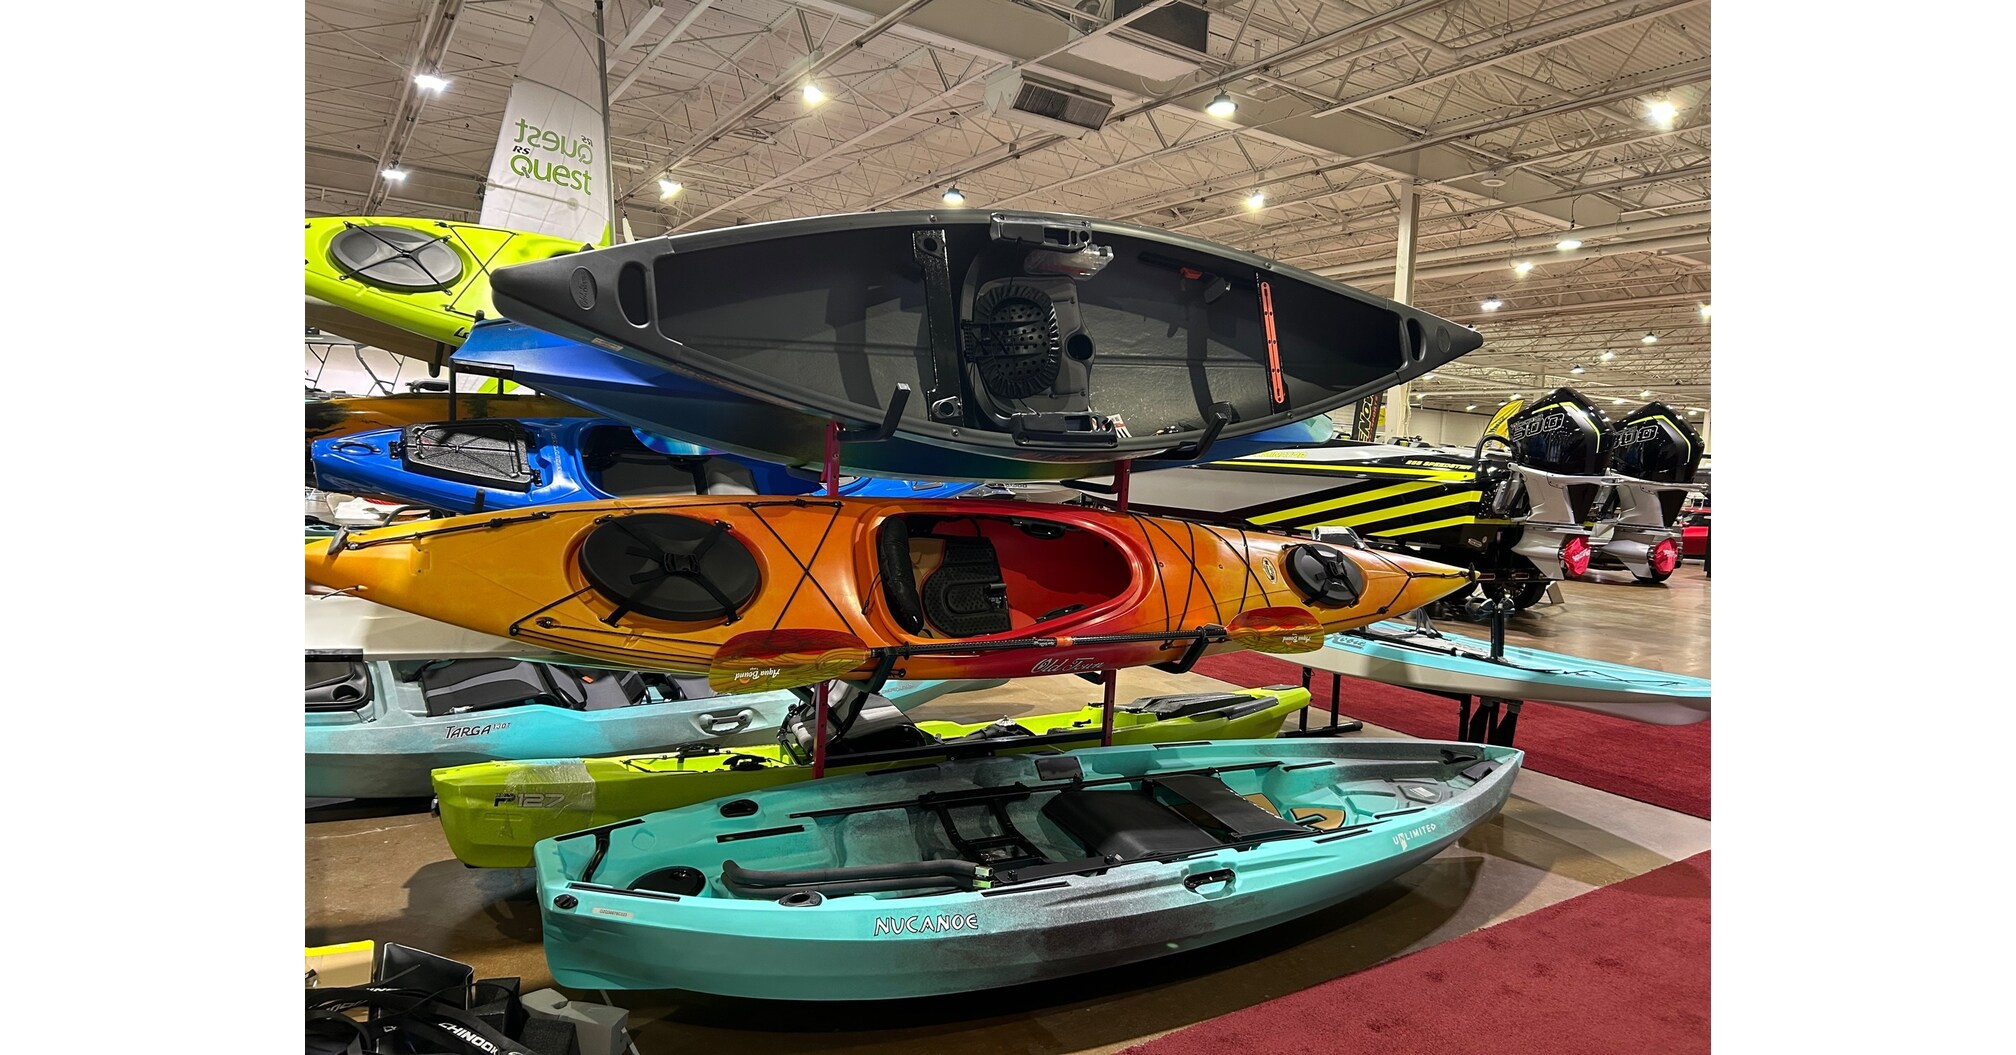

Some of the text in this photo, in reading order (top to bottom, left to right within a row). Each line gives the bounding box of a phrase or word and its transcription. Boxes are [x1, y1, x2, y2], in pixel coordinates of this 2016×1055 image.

[512, 145, 531, 155] RS
[510, 154, 592, 196] Quest
[1512, 413, 1565, 442] 500
[733, 667, 781, 681] Aqua Bound
[446, 724, 493, 740] TARGA
[493, 793, 566, 809] P127
[873, 912, 980, 937] NUCANOE
